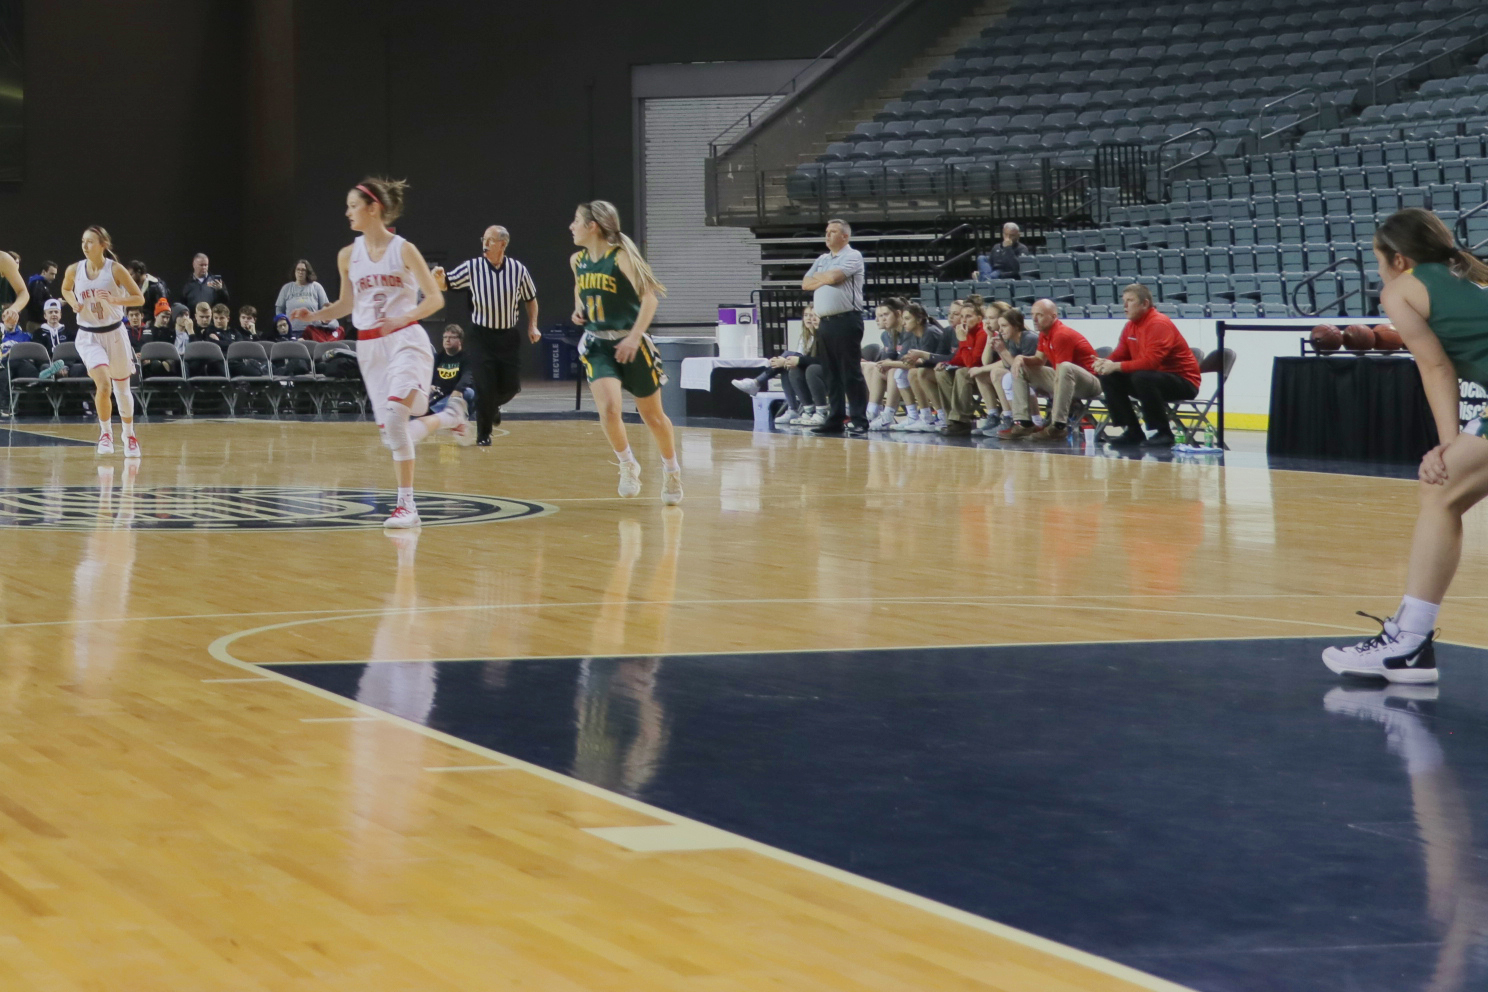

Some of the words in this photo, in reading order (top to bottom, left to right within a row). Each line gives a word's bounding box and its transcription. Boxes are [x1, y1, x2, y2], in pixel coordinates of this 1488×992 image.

[91, 302, 104, 320] 4
[586, 295, 605, 323] 11
[552, 343, 560, 379] RECYCLE
